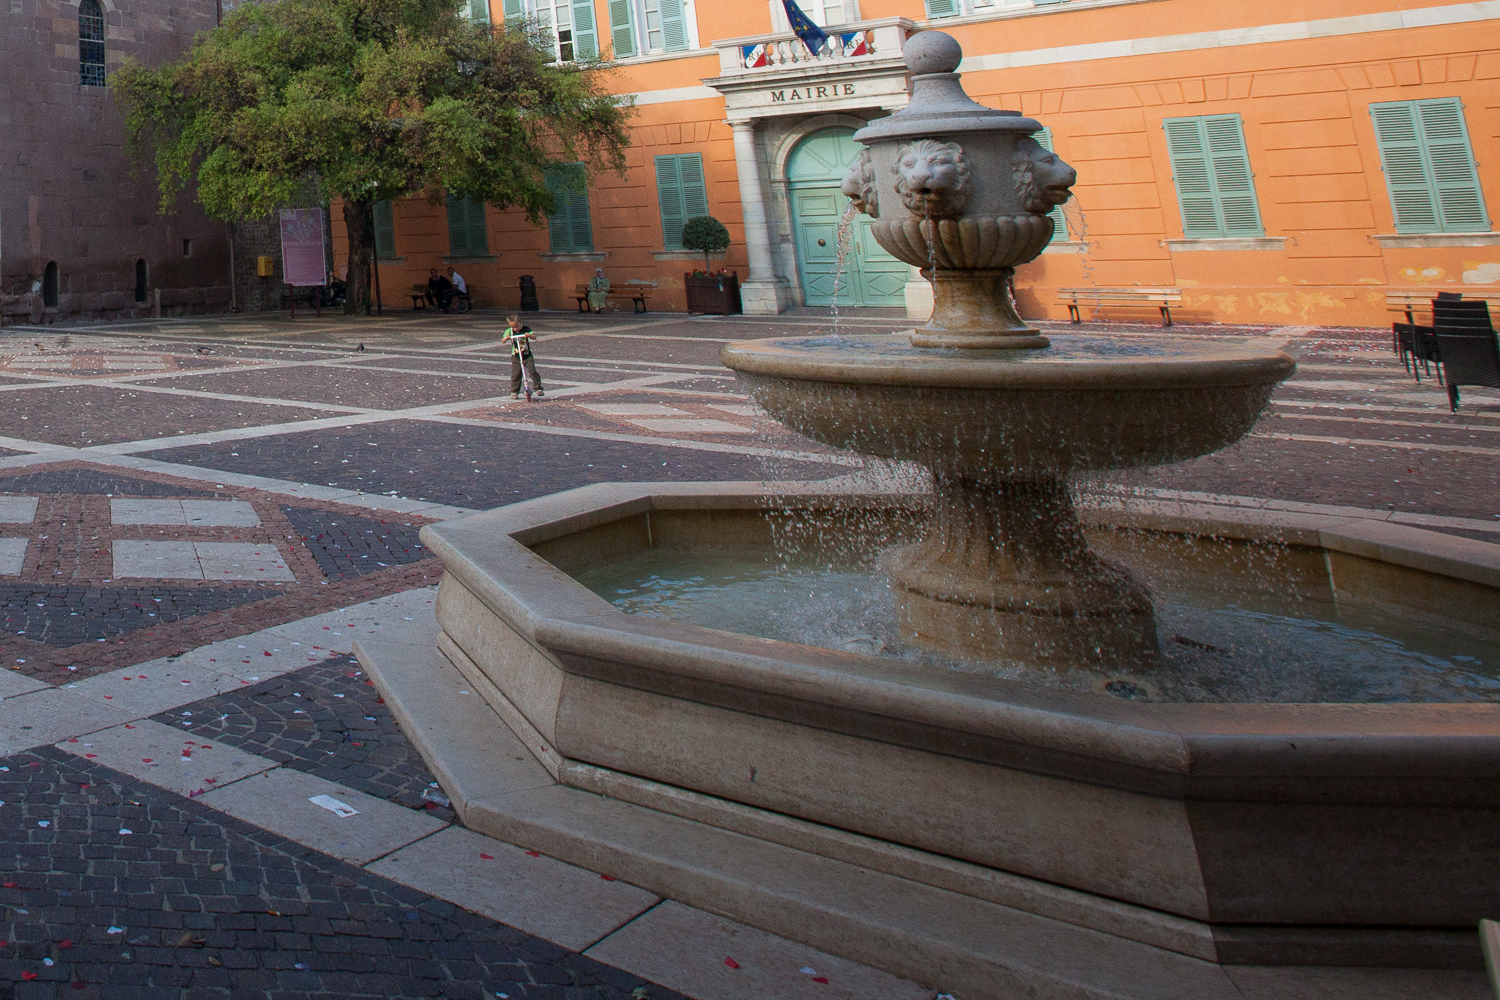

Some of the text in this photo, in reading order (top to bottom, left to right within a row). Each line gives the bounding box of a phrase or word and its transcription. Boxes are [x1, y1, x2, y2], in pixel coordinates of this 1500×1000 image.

[845, 38, 862, 50] RF
[747, 50, 762, 61] RF
[771, 83, 856, 103] MAIRIE
